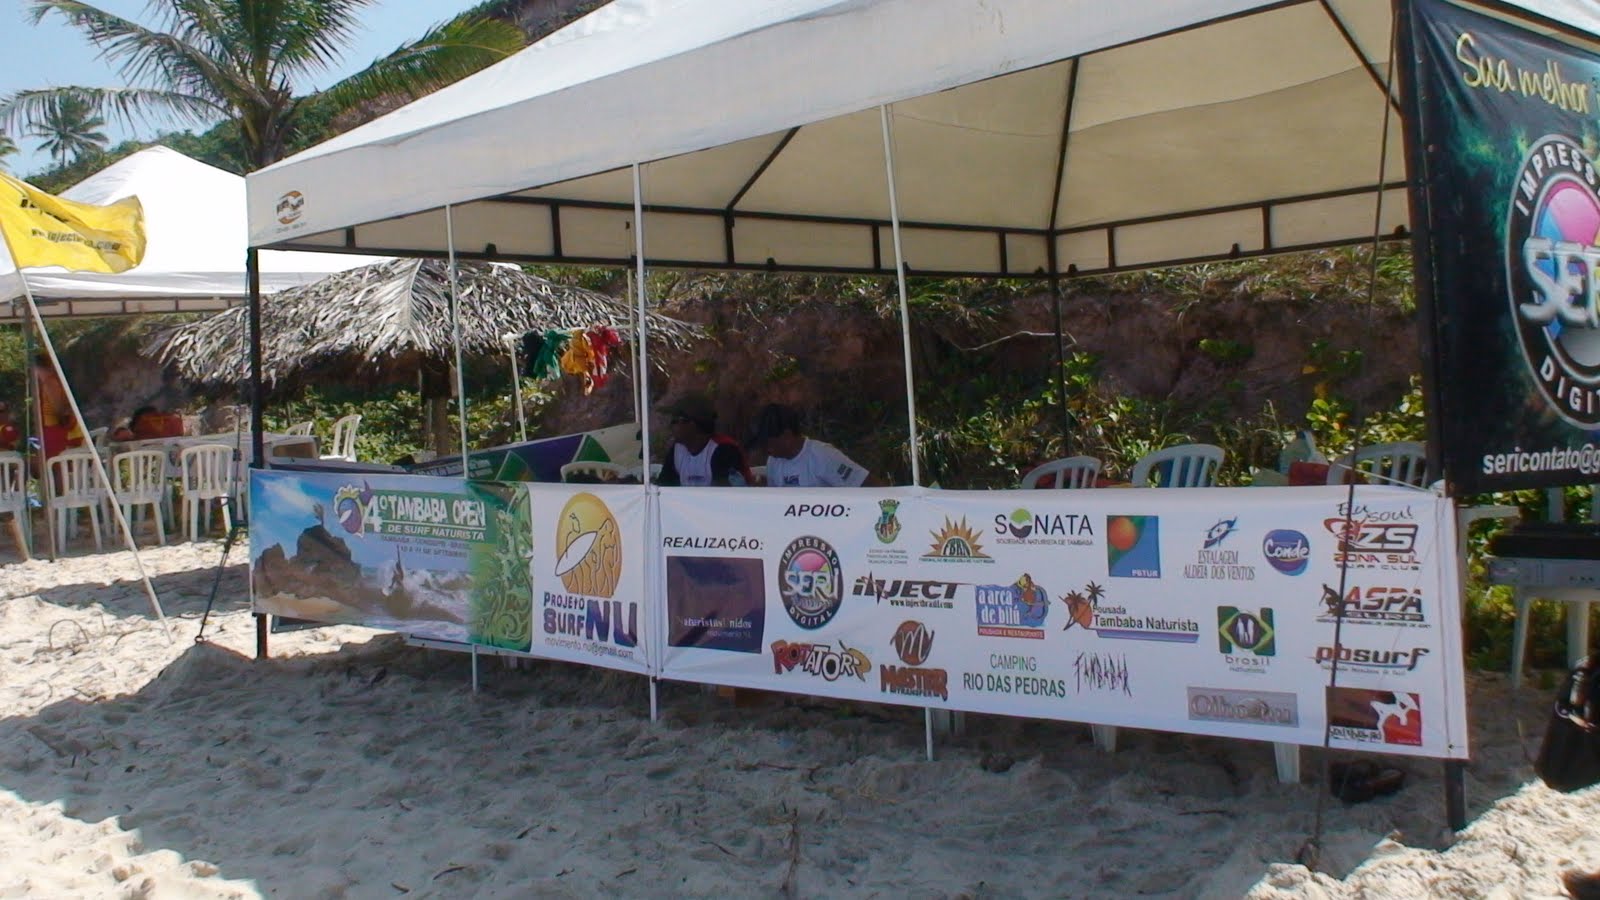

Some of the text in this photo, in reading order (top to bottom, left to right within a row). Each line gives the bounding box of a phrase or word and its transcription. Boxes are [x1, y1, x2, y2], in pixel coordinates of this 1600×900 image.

[1456, 33, 1590, 114] Sua melhor
[1515, 143, 1600, 216] IMPRESS
[1540, 355, 1600, 414] DIGI
[386, 495, 449, 523] TAMBABA
[452, 500, 486, 526] OPEN
[784, 504, 851, 517] APOIO:
[387, 524, 486, 540] DE SURF NATURISTA
[995, 508, 1093, 538] SONATA
[663, 536, 764, 551] REALIZAÇÃO:
[1264, 539, 1310, 561] Conde
[1198, 551, 1239, 564] ESTALAGEM
[1333, 553, 1421, 564] ZONA SUL
[1210, 565, 1226, 580] DOS
[978, 589, 1013, 606] a arca
[1343, 586, 1424, 613] ASPA
[543, 599, 638, 648] SURF NU
[981, 604, 1021, 625] de bilú
[1094, 614, 1200, 632] Tambaba Naturista
[990, 654, 1037, 672] CAMPING
[963, 672, 1066, 699] RIO DAS PEDRAS
